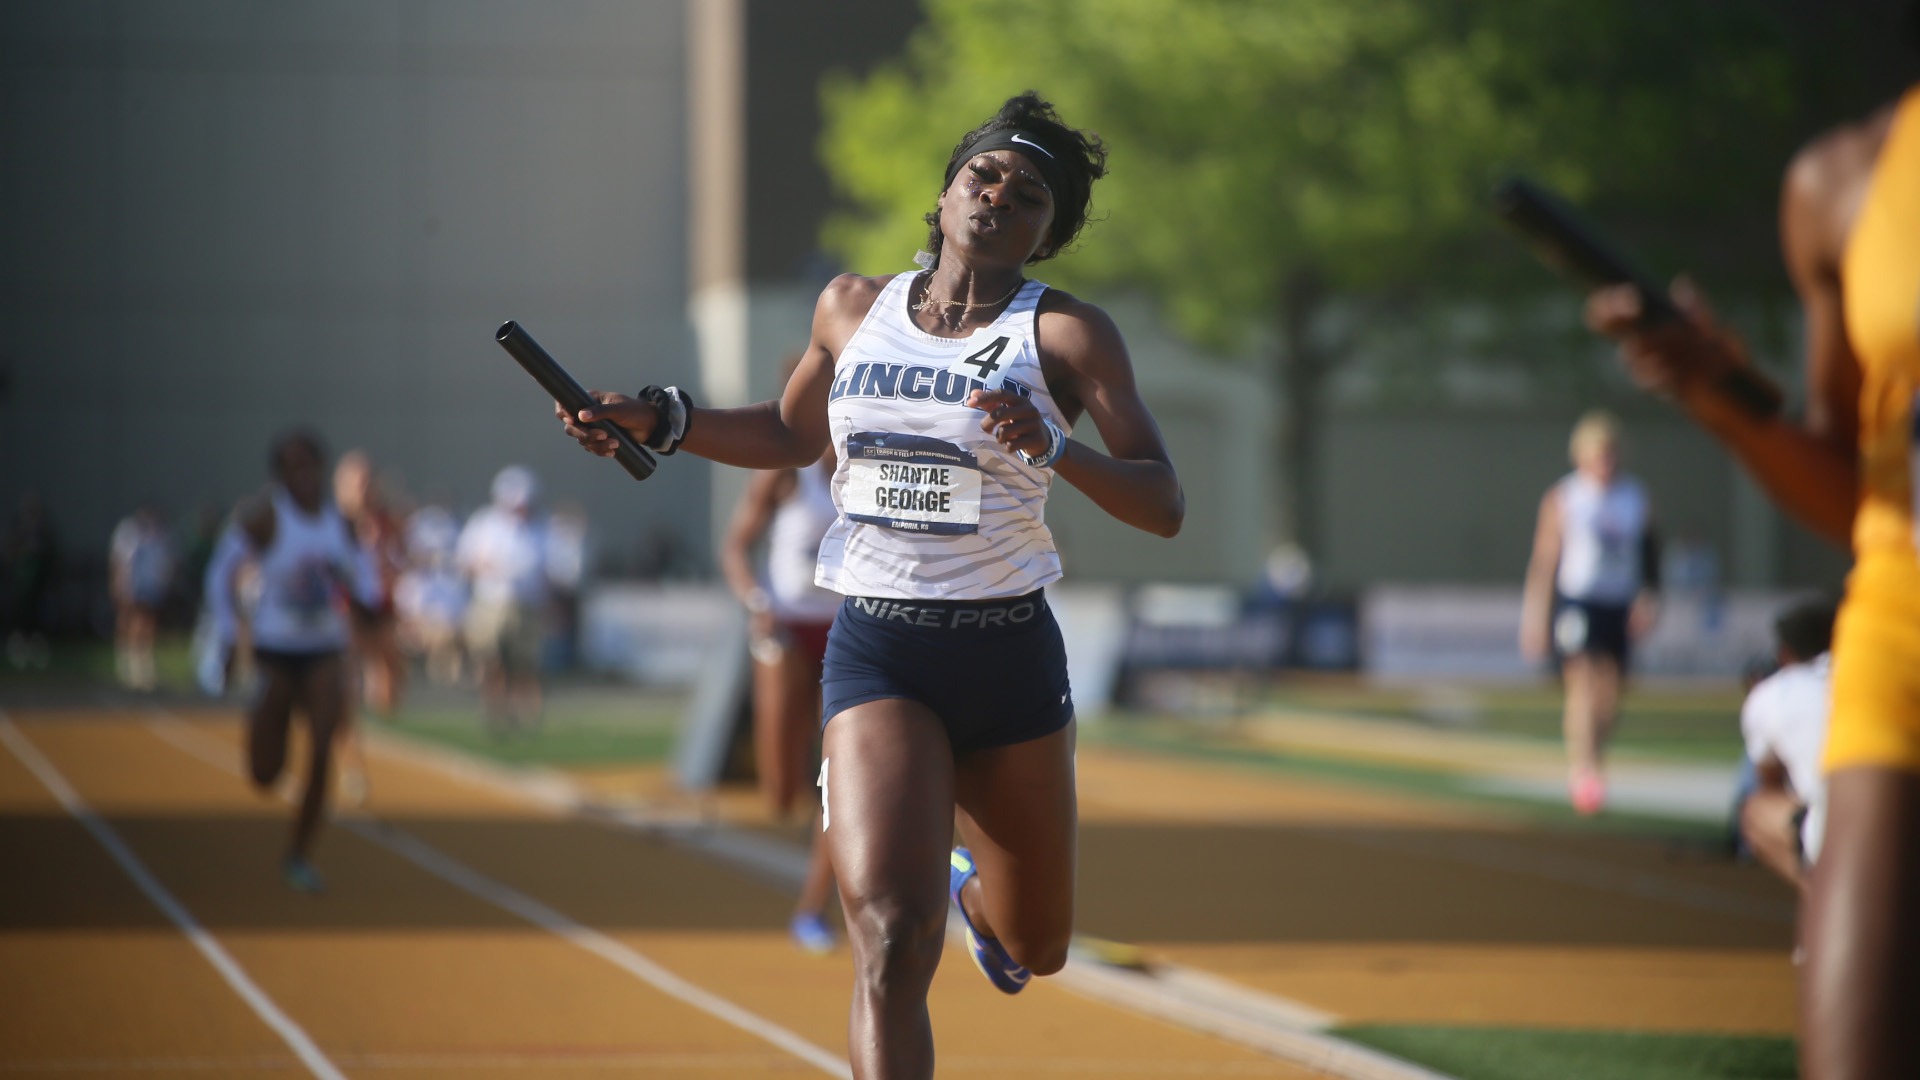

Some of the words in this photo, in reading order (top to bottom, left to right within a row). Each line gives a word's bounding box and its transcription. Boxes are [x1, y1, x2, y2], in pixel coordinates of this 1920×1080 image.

[964, 335, 1010, 379] 4
[876, 448, 893, 456] TRACK
[898, 450, 914, 458] FIELD
[915, 450, 961, 462] CHAMPIONSHIPS
[879, 463, 949, 486] SHANTAE
[875, 486, 950, 513] GEORGE
[854, 597, 946, 628] NIKE
[950, 602, 1034, 629] PRO
